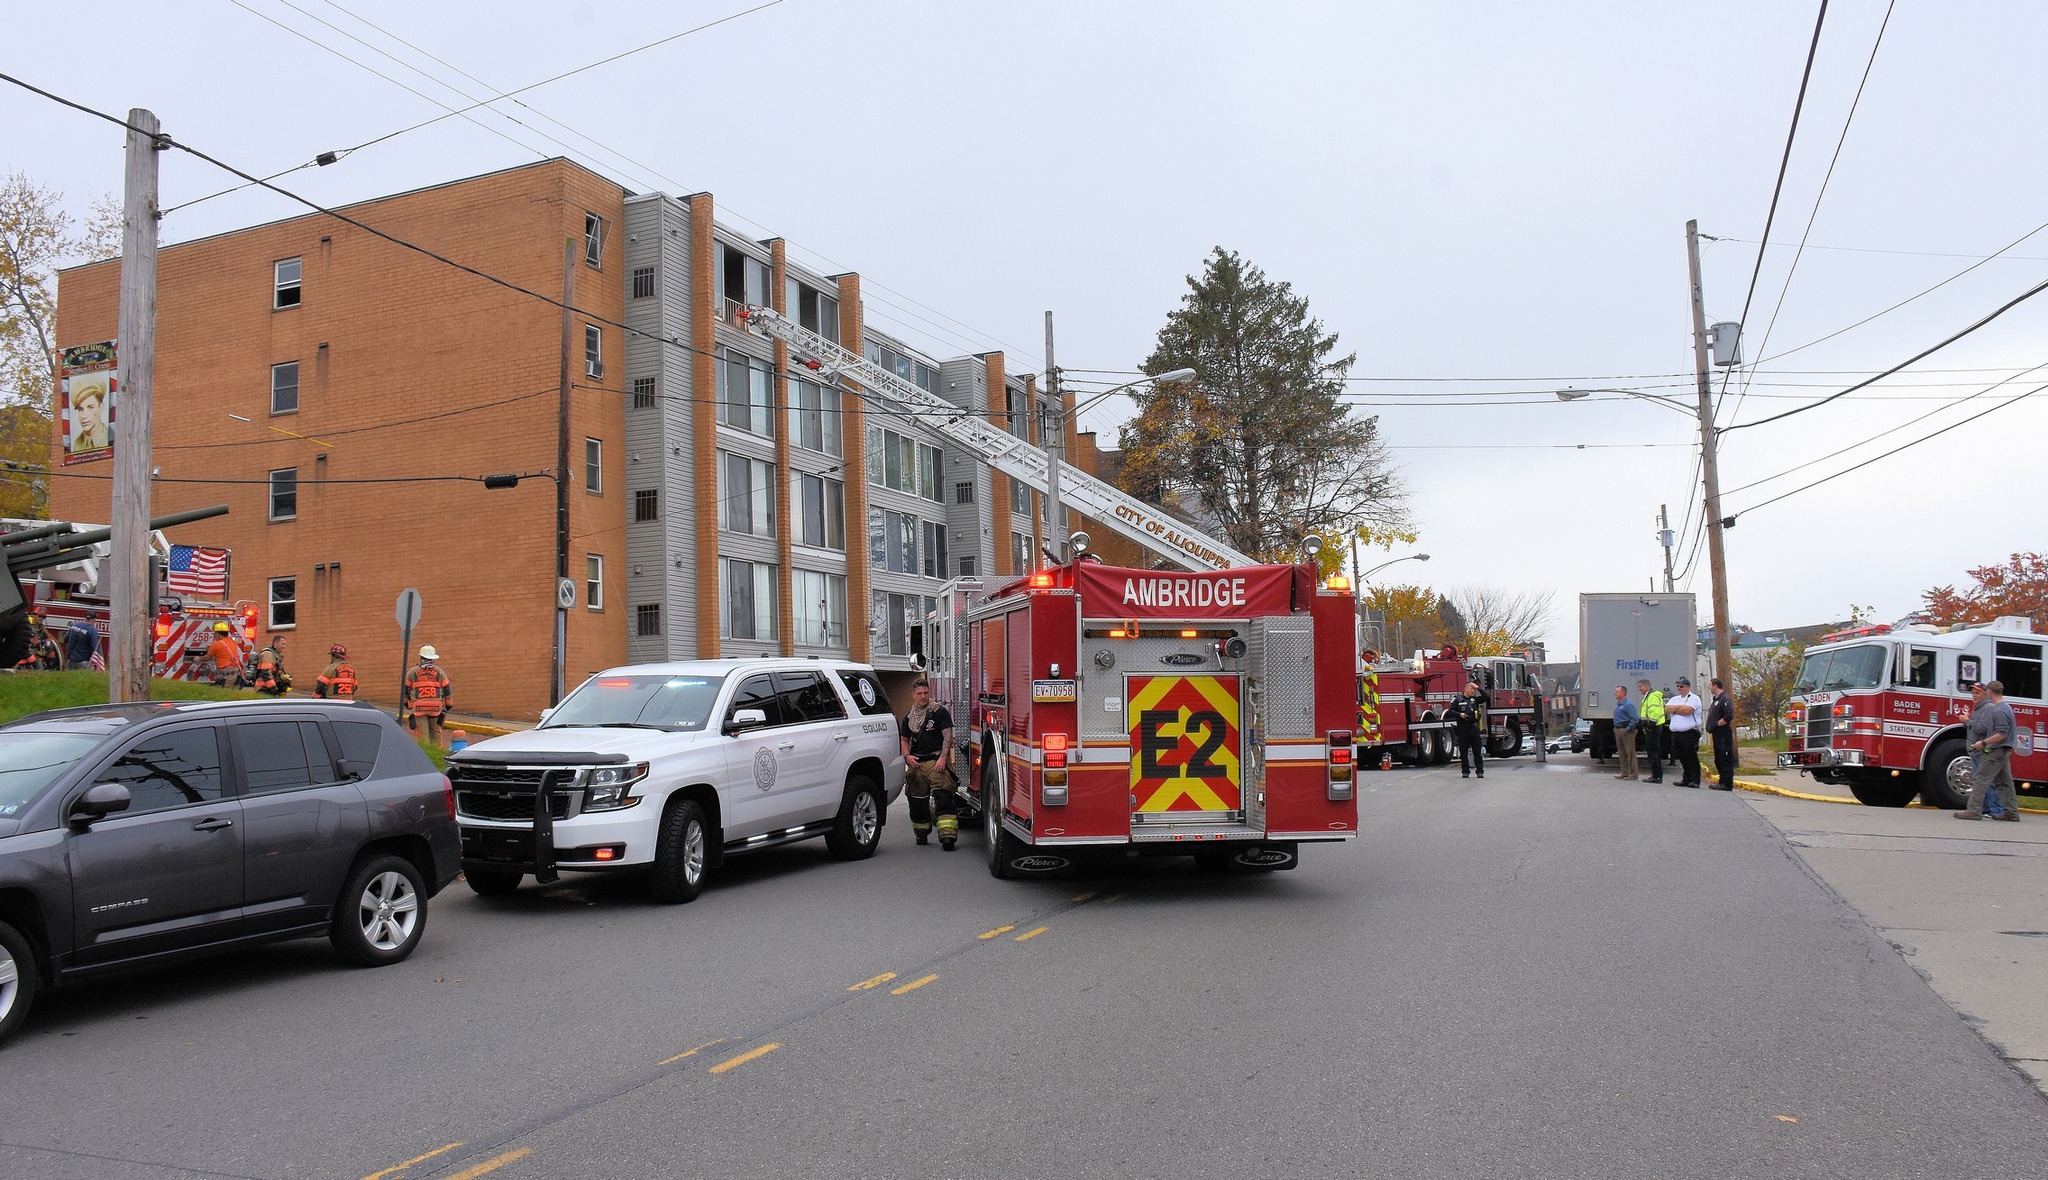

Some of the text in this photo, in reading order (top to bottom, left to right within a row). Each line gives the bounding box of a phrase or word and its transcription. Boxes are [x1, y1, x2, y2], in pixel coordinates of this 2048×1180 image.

[1115, 504, 1231, 570] CITY OF ALIQUIPPA
[1122, 578, 1246, 607] AMBRIDGE
[1170, 653, 1198, 665] Pierce
[1616, 659, 1659, 670] FirstFleet
[418, 687, 437, 698] 258
[1810, 692, 1831, 704] BADEN
[1894, 700, 1921, 709] BADEN
[2013, 707, 2034, 715] CLASS
[862, 722, 888, 734] SQUAD
[1889, 725, 1915, 734] STATION
[1141, 710, 1227, 778] E2
[91, 898, 148, 913] COMPASS
